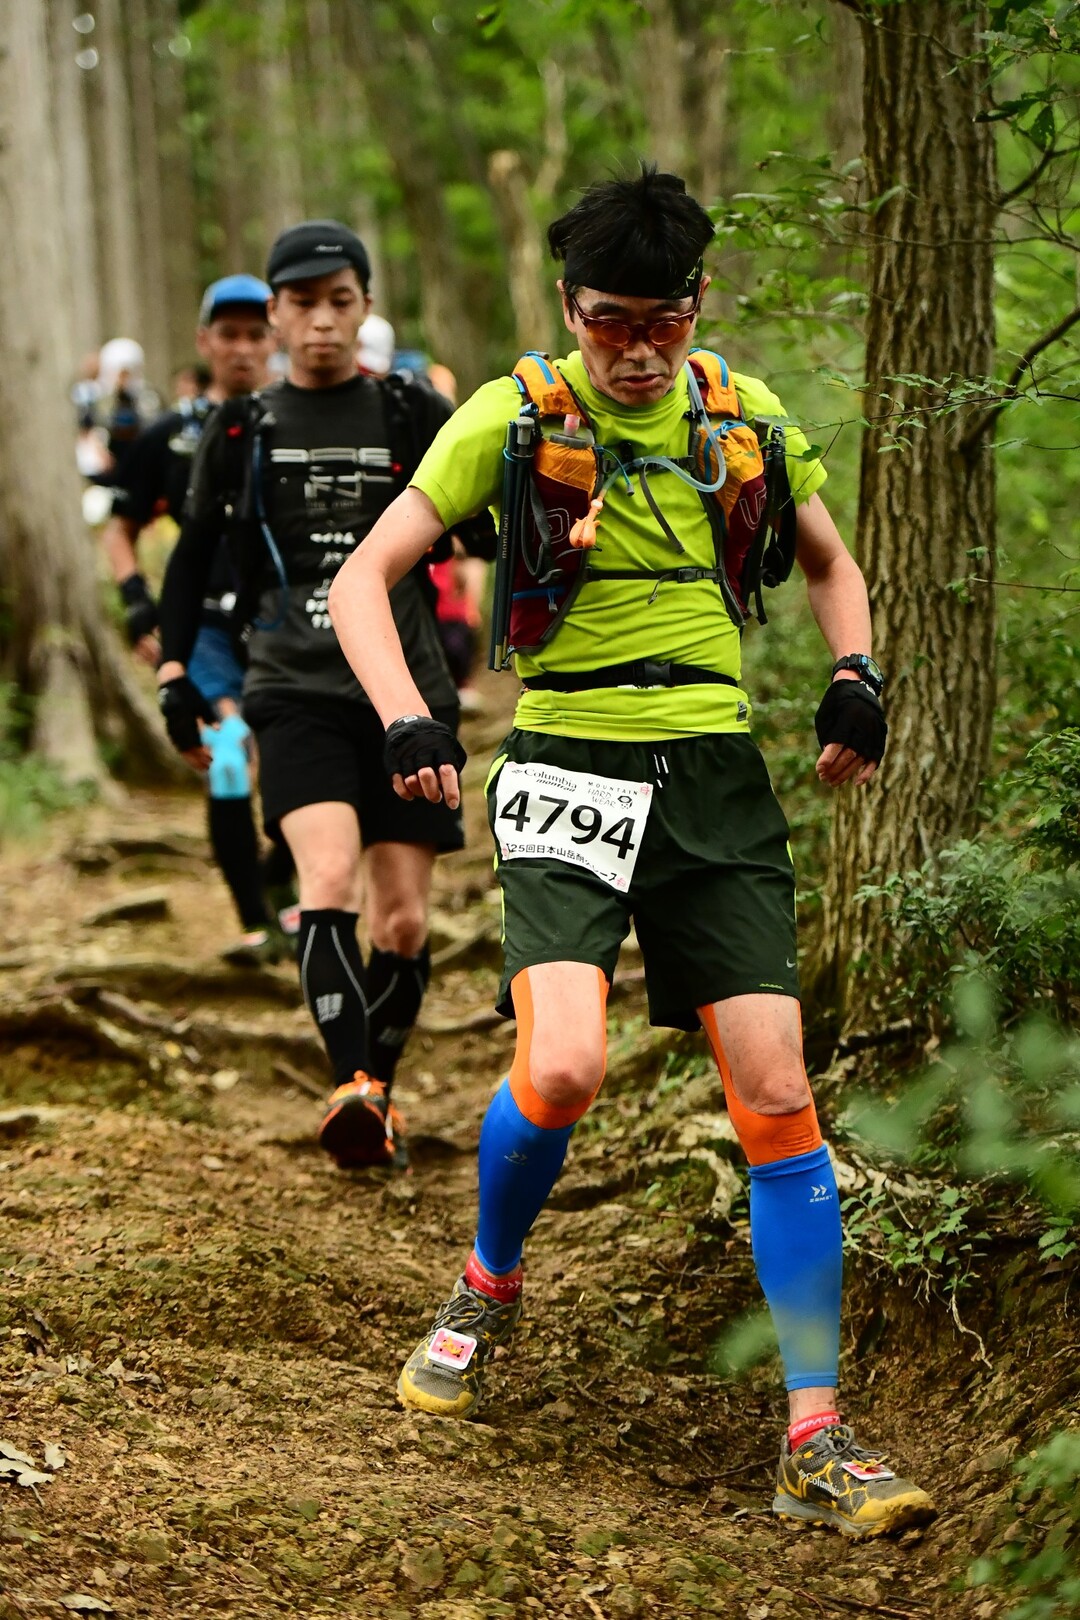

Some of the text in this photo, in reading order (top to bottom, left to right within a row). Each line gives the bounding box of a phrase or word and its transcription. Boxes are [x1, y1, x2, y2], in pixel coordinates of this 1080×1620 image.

[524, 768, 578, 790] Columbia
[587, 781, 638, 796] MOUNTAIN
[499, 789, 636, 860] 4794
[806, 1472, 841, 1497] Columbia
